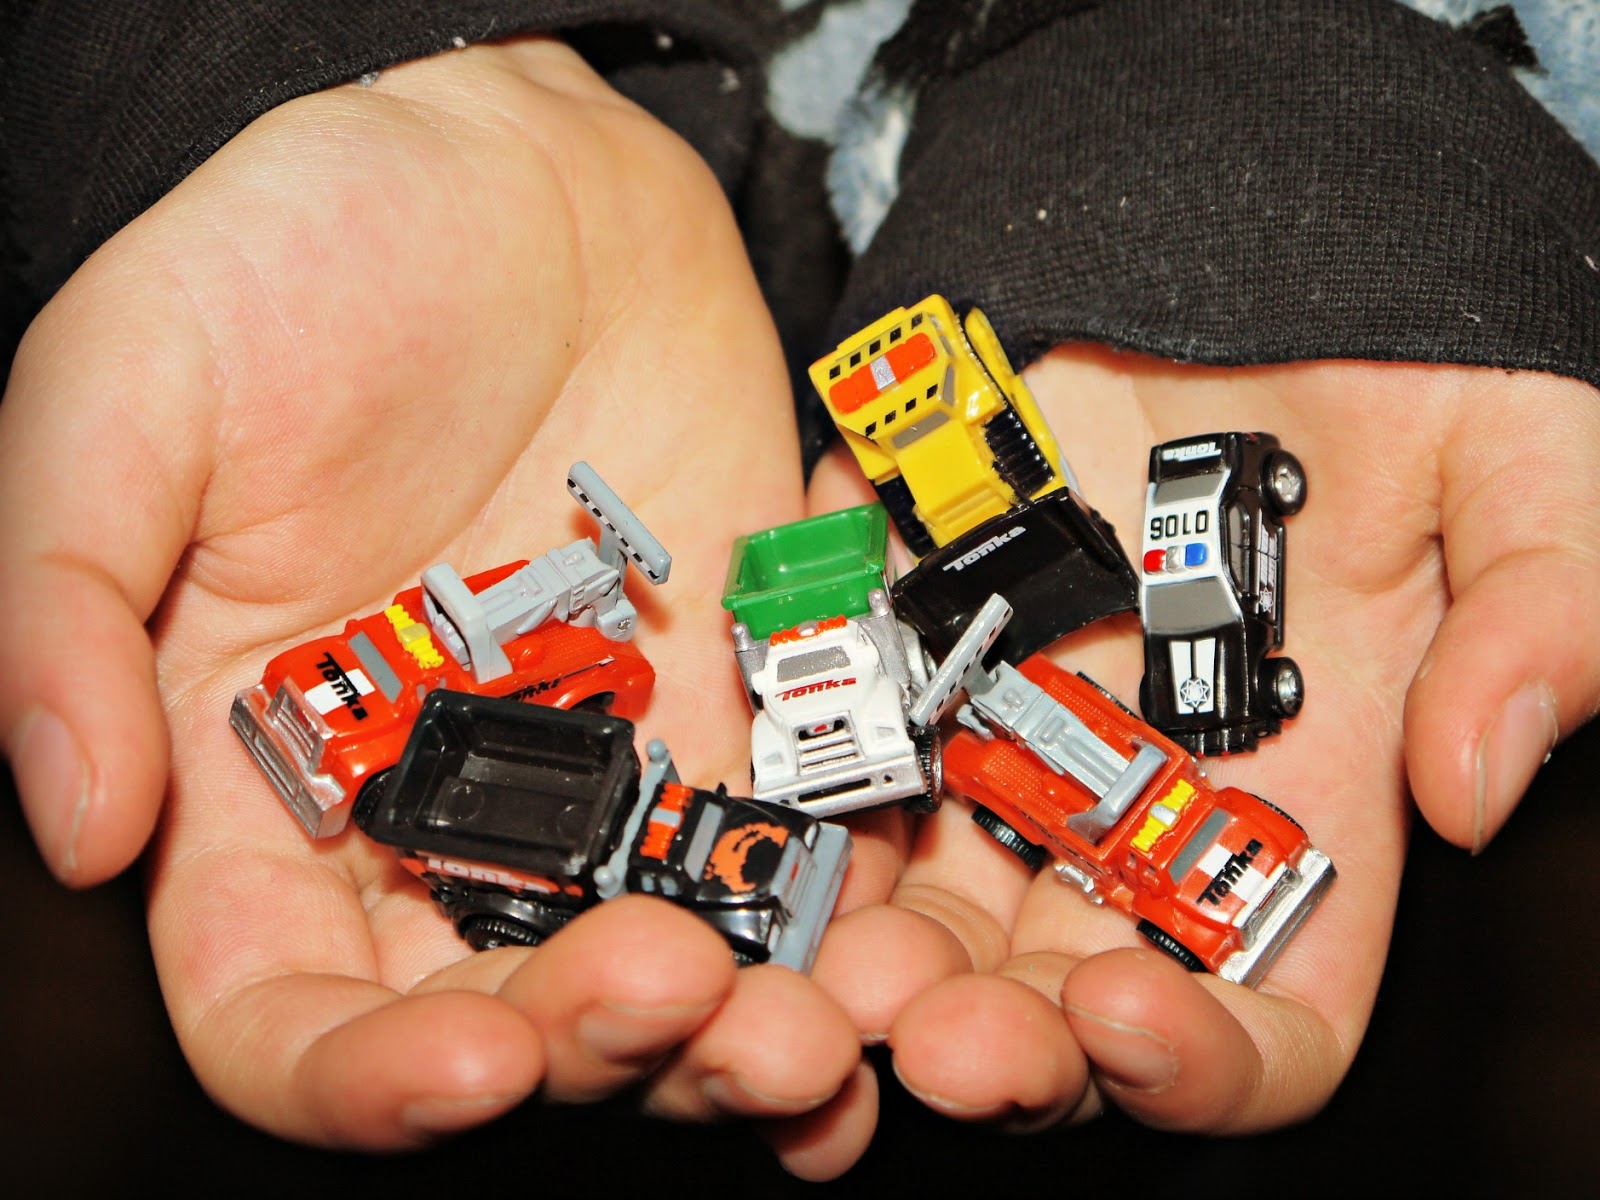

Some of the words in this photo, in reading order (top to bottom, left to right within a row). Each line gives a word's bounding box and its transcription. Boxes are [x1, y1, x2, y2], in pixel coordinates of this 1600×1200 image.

[1150, 509, 1209, 541] 0106
[942, 526, 1027, 572] Tonka
[316, 651, 369, 721] Tonka
[774, 677, 857, 702] Tonka
[1195, 838, 1264, 906] Tonka
